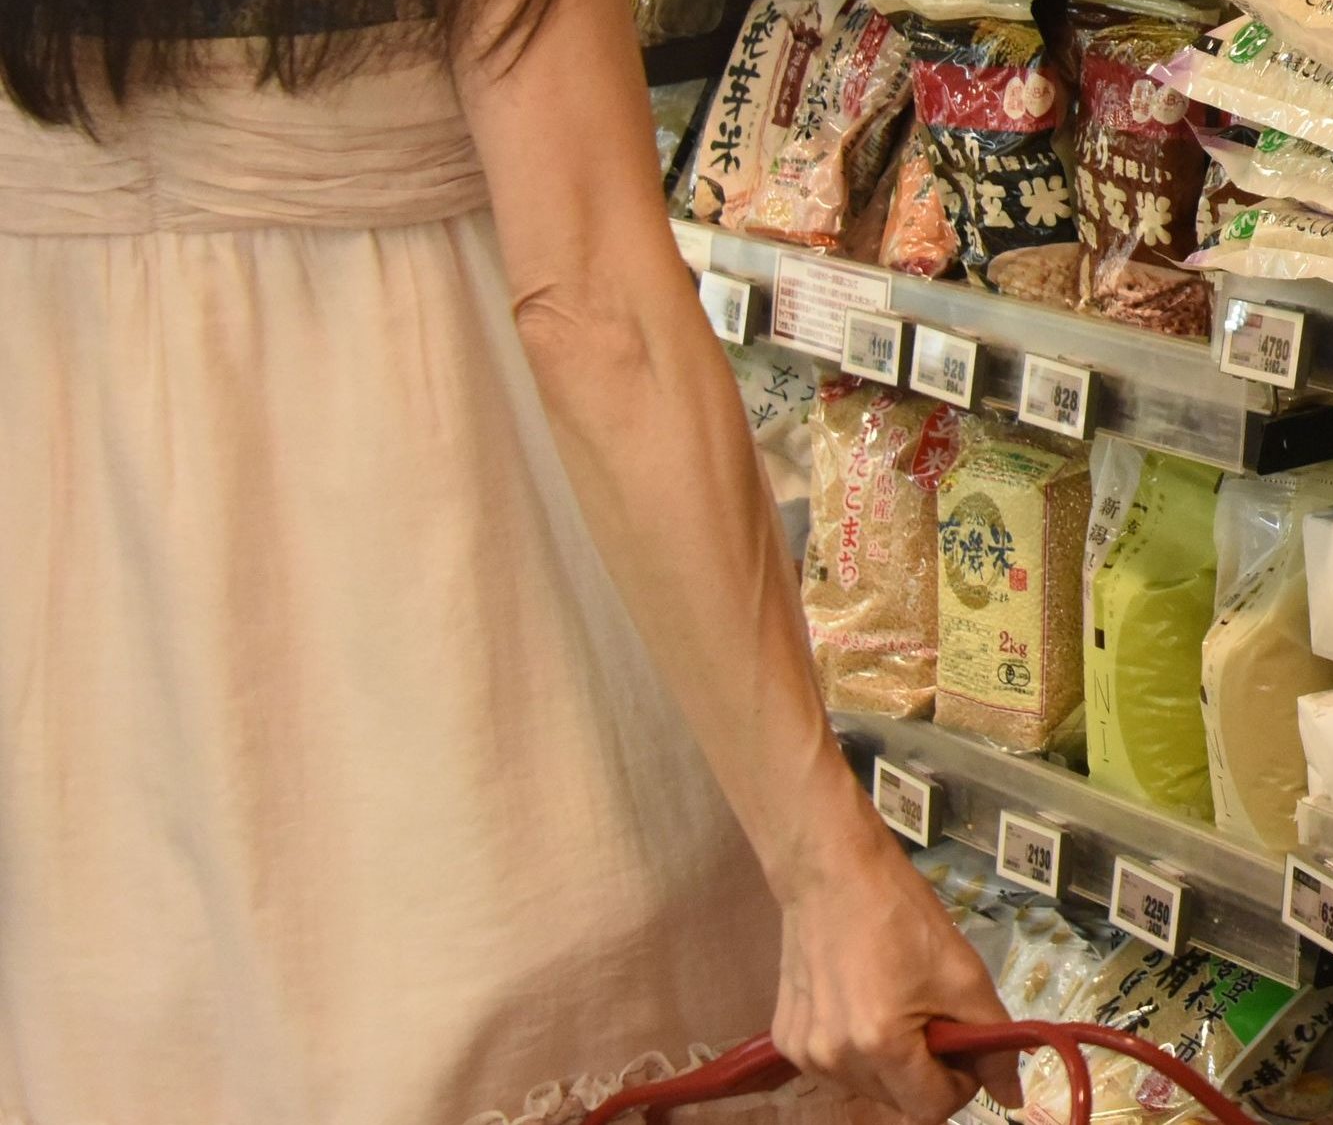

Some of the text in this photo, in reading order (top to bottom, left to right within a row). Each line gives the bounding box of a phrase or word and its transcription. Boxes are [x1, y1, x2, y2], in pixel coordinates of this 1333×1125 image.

[1259, 331, 1289, 361] 4780
[1054, 387, 1079, 412] 828
[937, 515, 1017, 581] 有機米
[998, 629, 1029, 660] 2kg
[1027, 842, 1052, 873] 2130
[1143, 893, 1170, 926] 2250
